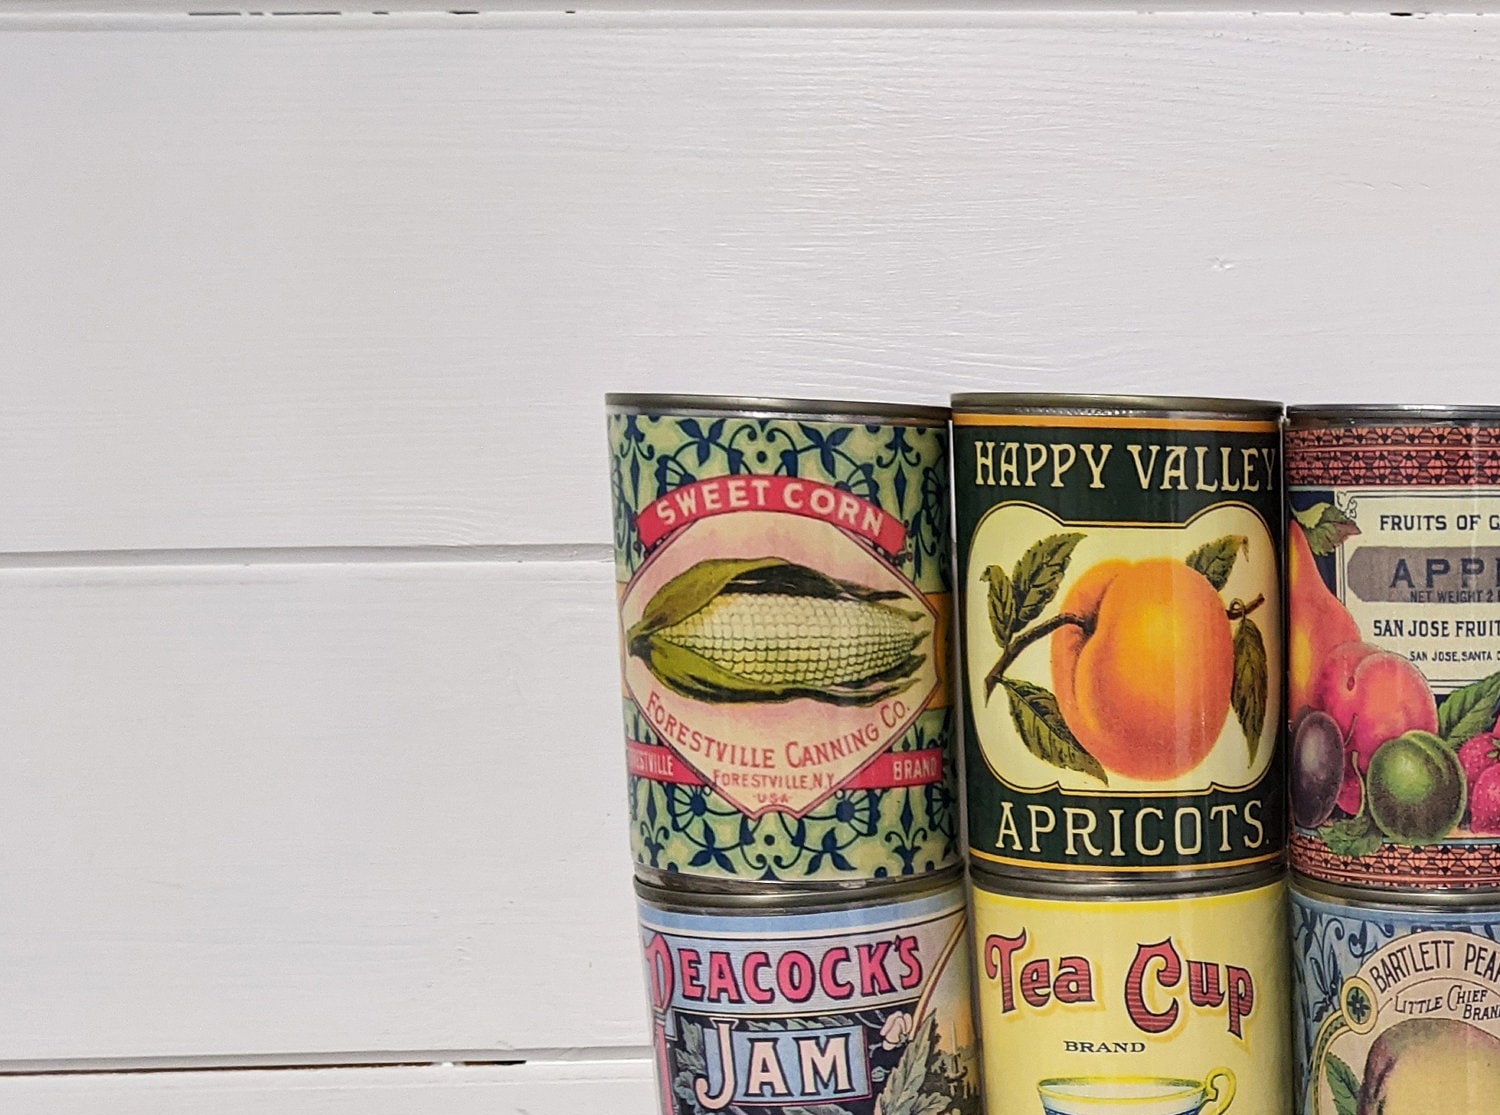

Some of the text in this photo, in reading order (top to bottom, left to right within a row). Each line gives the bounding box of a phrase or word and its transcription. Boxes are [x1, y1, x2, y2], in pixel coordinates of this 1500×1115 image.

[974, 441, 1276, 492] HAPPY VALLEY
[656, 479, 884, 537] SWEET CORN
[1380, 514, 1447, 531] FRUITS
[1456, 514, 1481, 531] OF
[1410, 590, 1433, 603] NET
[1437, 590, 1483, 603] WEIGHT
[1486, 590, 1495, 602] 2
[1373, 619, 1404, 637] SAN
[1408, 620, 1450, 637] JOSE
[1409, 651, 1428, 662] SAN
[646, 692, 911, 769] FORESTVILLE CANNING CO.
[892, 757, 937, 781] BRAND
[645, 932, 924, 1013] PEACOCK'S
[984, 927, 1255, 1040] Tea Cup
[1370, 939, 1454, 995] BARTLETT
[1393, 983, 1488, 1016] LITTLE CHIEF
[695, 1017, 856, 1110] JAM
[1063, 1039, 1146, 1054] BRAND
